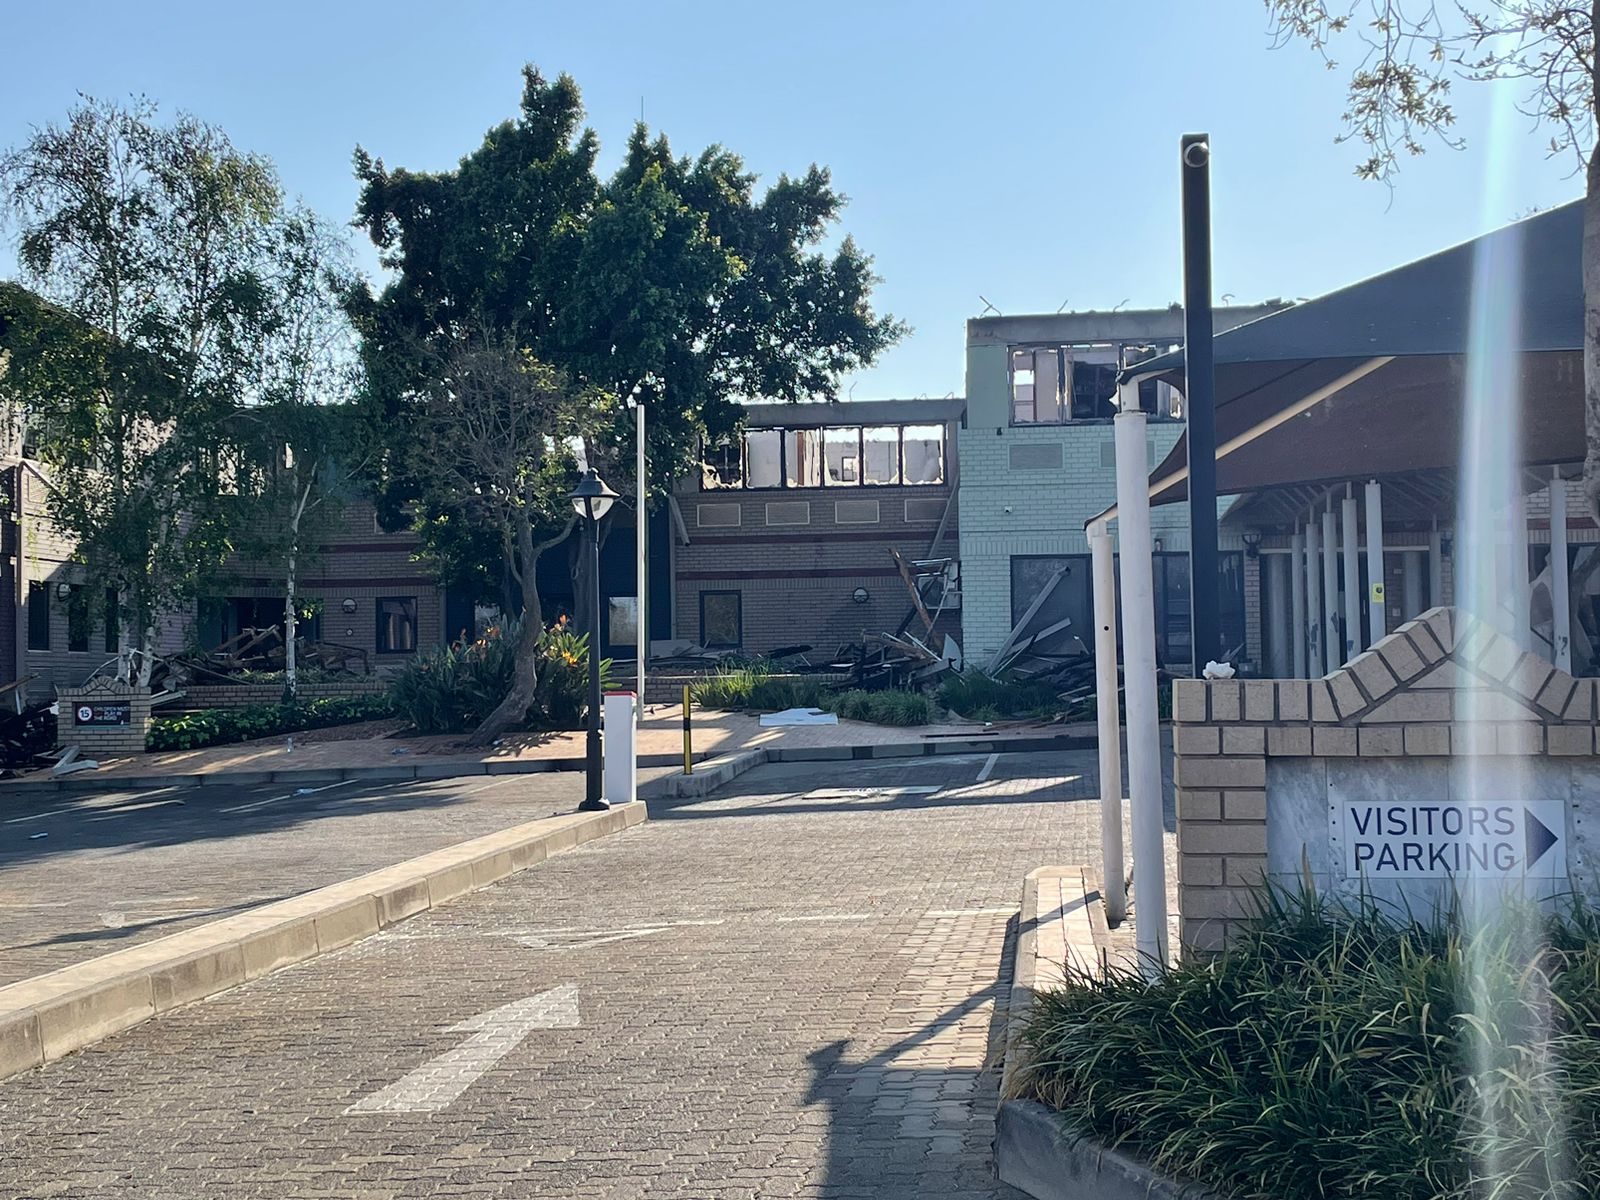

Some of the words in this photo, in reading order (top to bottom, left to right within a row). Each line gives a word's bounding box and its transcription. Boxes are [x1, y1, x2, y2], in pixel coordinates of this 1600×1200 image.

[80, 709, 90, 718] 15
[1351, 806, 1515, 836] VISITORS
[1354, 842, 1515, 871] PARKING
